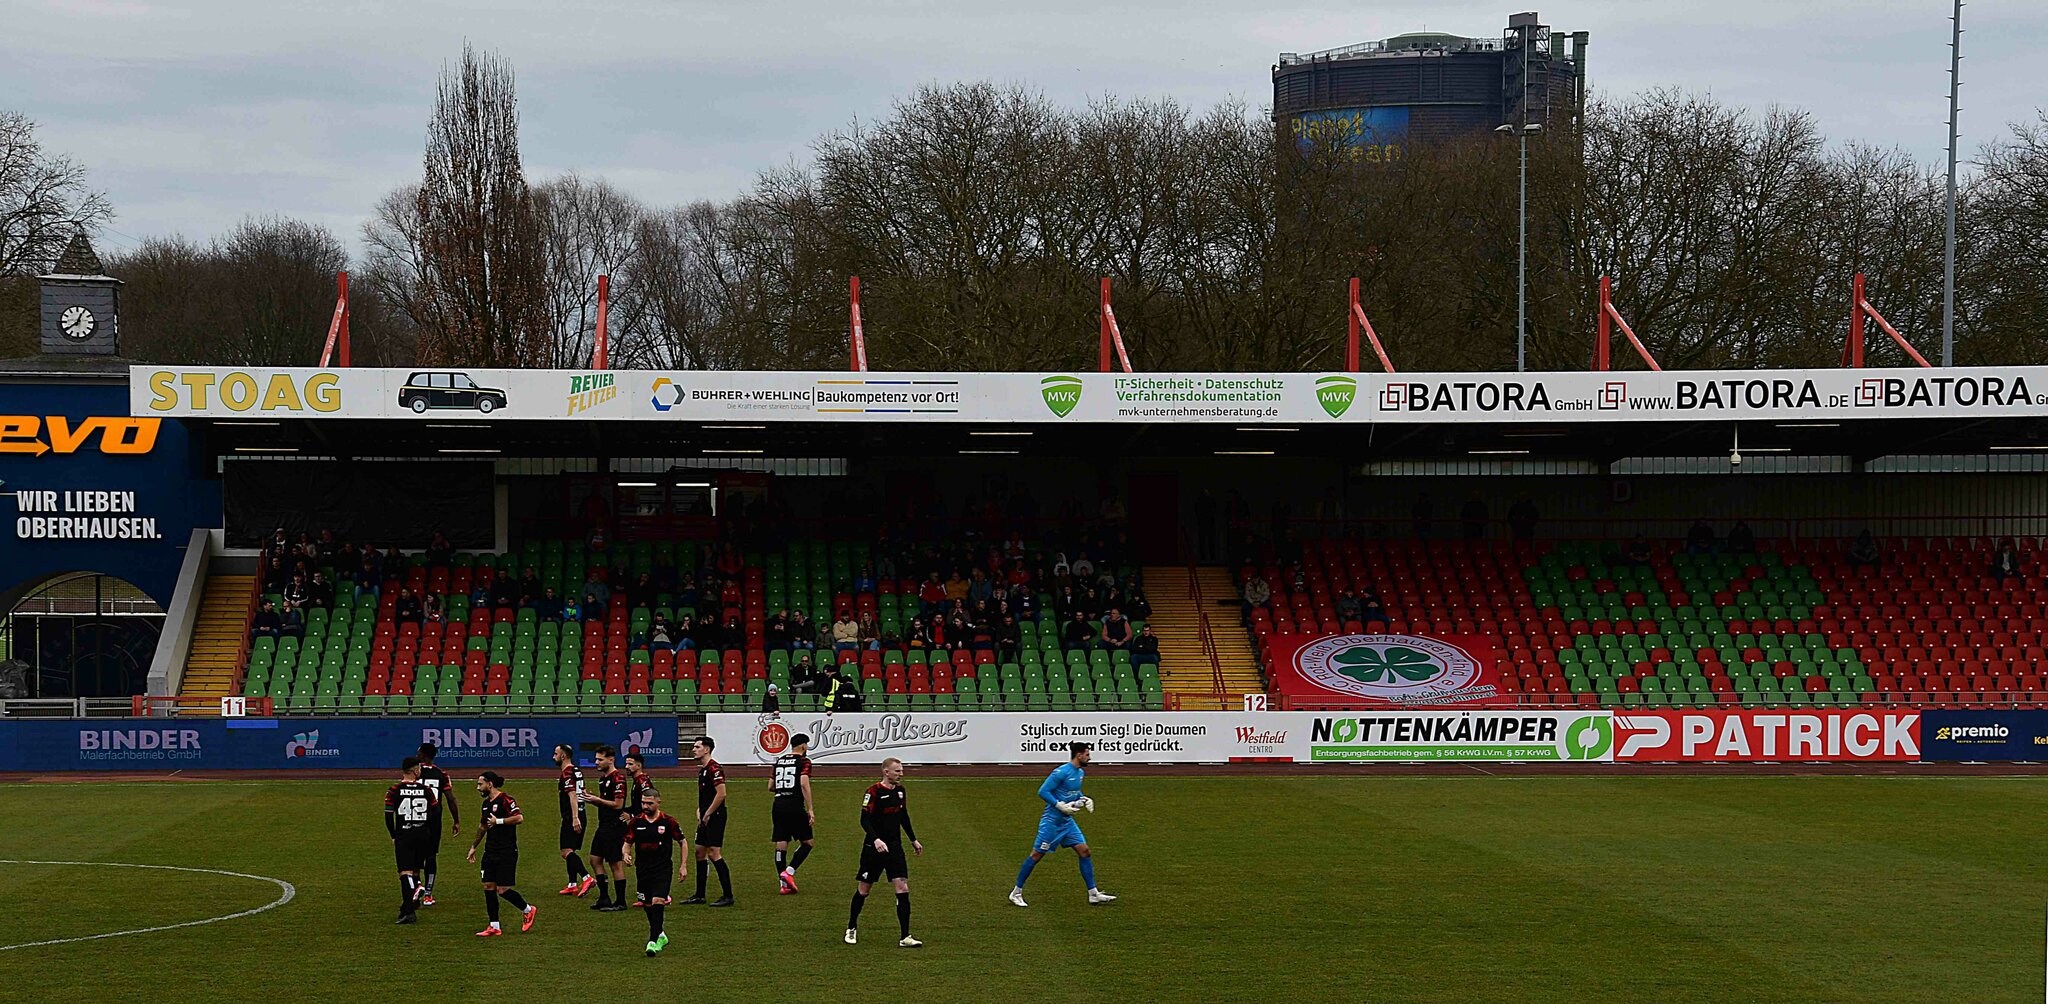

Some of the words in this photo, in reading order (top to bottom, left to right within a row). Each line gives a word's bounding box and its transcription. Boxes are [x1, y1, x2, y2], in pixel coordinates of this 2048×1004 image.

[148, 370, 342, 412] STOAG
[570, 373, 615, 395] REVIER
[1114, 378, 1194, 389] IT-Sicherheit
[1205, 378, 1283, 389] Datenschutz
[1885, 376, 2033, 407] BATORA
[567, 386, 617, 417] FLITZER
[692, 389, 811, 401] BÜHRER+WEHLING
[817, 391, 908, 405] Baukompetenz
[911, 394, 933, 404] vor
[935, 391, 959, 403] Ort!
[1047, 391, 1077, 402] MVK
[1116, 390, 1281, 402] Verfahrensdokumentation
[1321, 391, 1351, 402] MVK
[1408, 382, 1551, 412] BATORA
[1554, 399, 1593, 411] GmbH
[1118, 406, 1279, 418] mvk-unternehmensberatung.de
[17, 490, 58, 513] WIR
[65, 490, 135, 513] LIEBEN
[17, 516, 162, 539] OBERHAUSEN.
[223, 698, 244, 715] 11
[1245, 695, 1266, 711] 12
[79, 730, 201, 749] BINDER
[422, 728, 539, 748] BINDER
[1020, 723, 1068, 739] Stylisch
[1071, 726, 1097, 736] zum
[1100, 723, 1130, 739] Sieg!
[1133, 723, 1153, 736] Die
[1155, 723, 1206, 736] Daumen
[1234, 726, 1288, 744] Westfield
[1682, 713, 1921, 757] PATRICK
[1951, 723, 2009, 740] premio
[80, 750, 165, 760] Malerfachbetrieb
[167, 750, 201, 759] GmbH
[435, 749, 504, 758] lerfachbetrieb
[507, 749, 540, 758] GmbH
[1020, 739, 1046, 752] sind
[1098, 739, 1121, 752] fest
[1124, 739, 1183, 754] gedrückt.
[1248, 745, 1273, 754] CENTRO
[1316, 750, 1412, 758] Entsorgungsfachbetrieb
[775, 766, 797, 789] 25
[397, 797, 428, 821] 42
